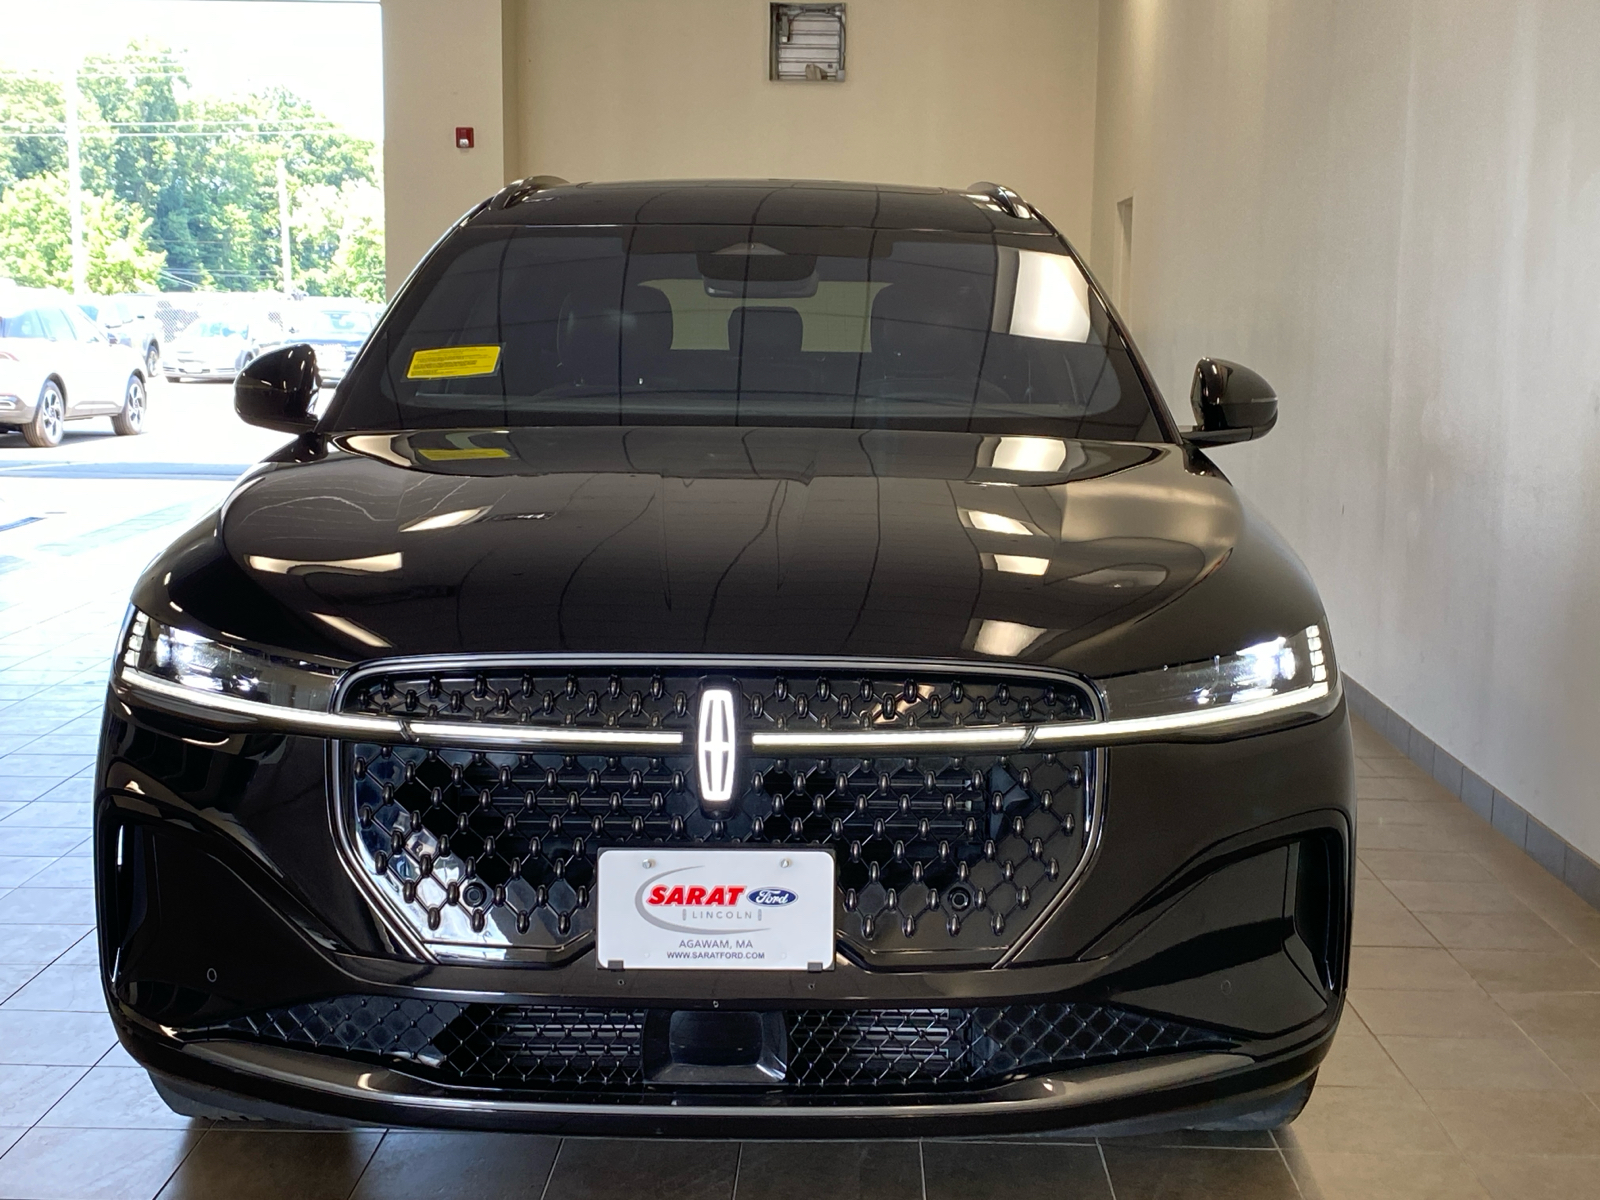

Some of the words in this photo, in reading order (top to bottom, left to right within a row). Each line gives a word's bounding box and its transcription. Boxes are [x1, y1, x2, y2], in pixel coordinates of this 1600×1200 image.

[647, 885, 746, 906] SARAT
[754, 888, 790, 905] Ford
[692, 910, 753, 920] LINCOLN
[678, 939, 732, 950] AGAWAM,
[735, 939, 754, 949] MA
[666, 951, 765, 960] WWW.SARATFORD.COM
